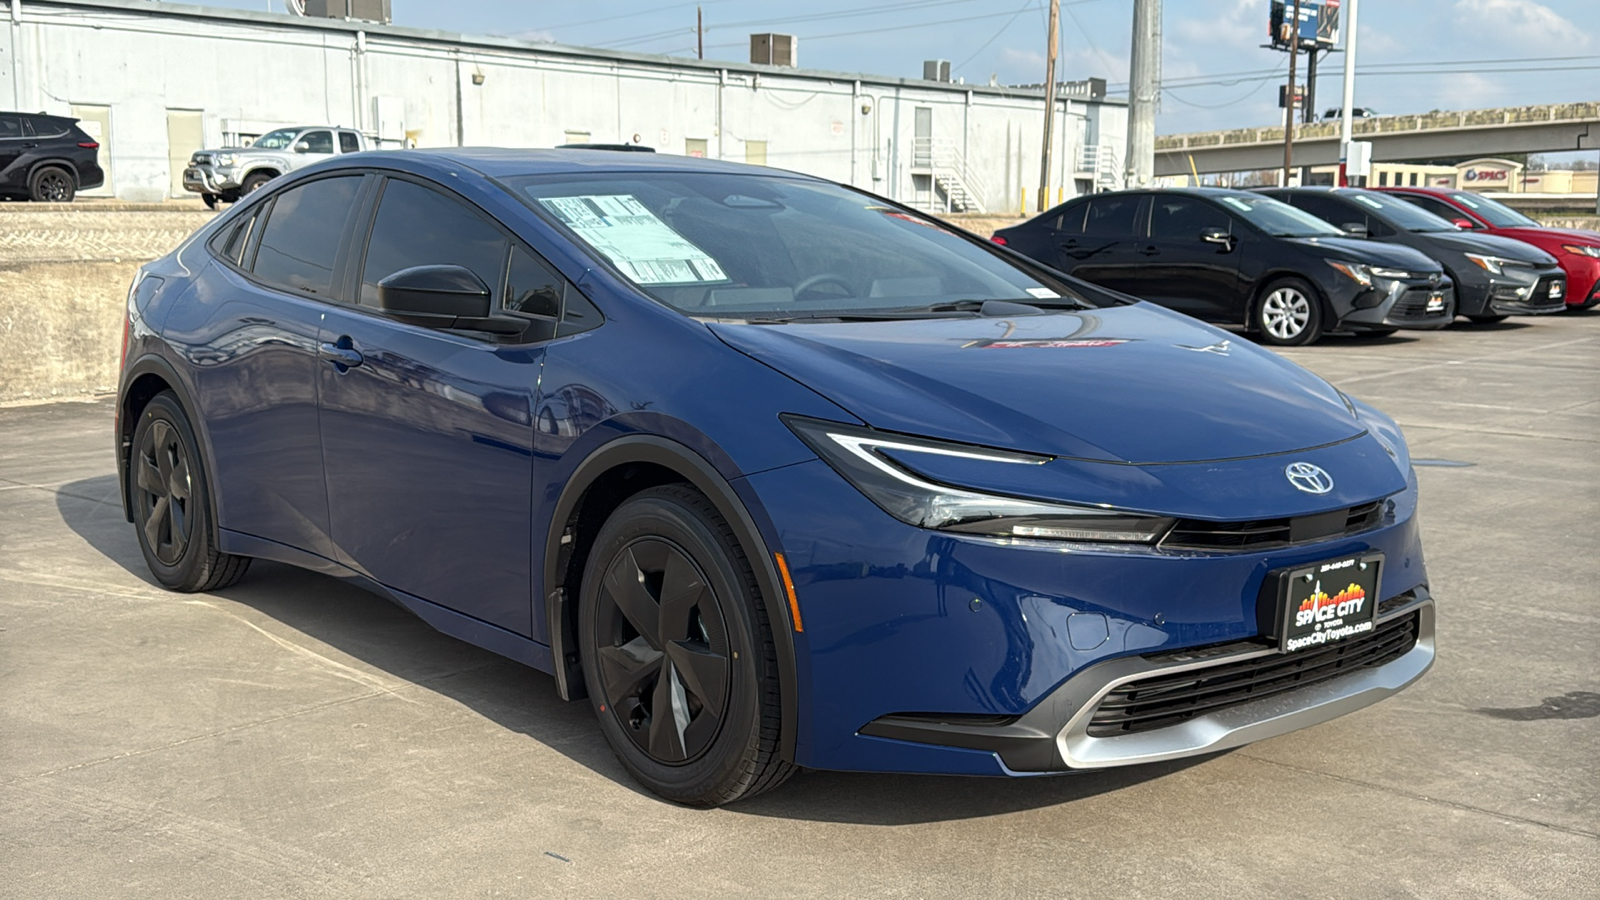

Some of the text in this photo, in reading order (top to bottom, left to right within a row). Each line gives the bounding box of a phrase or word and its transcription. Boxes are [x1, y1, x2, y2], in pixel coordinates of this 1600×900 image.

[1295, 597, 1366, 627] SPACE CITY
[1323, 618, 1344, 629] TOYOTA
[1286, 621, 1373, 651] SpaceCityToyota.com
